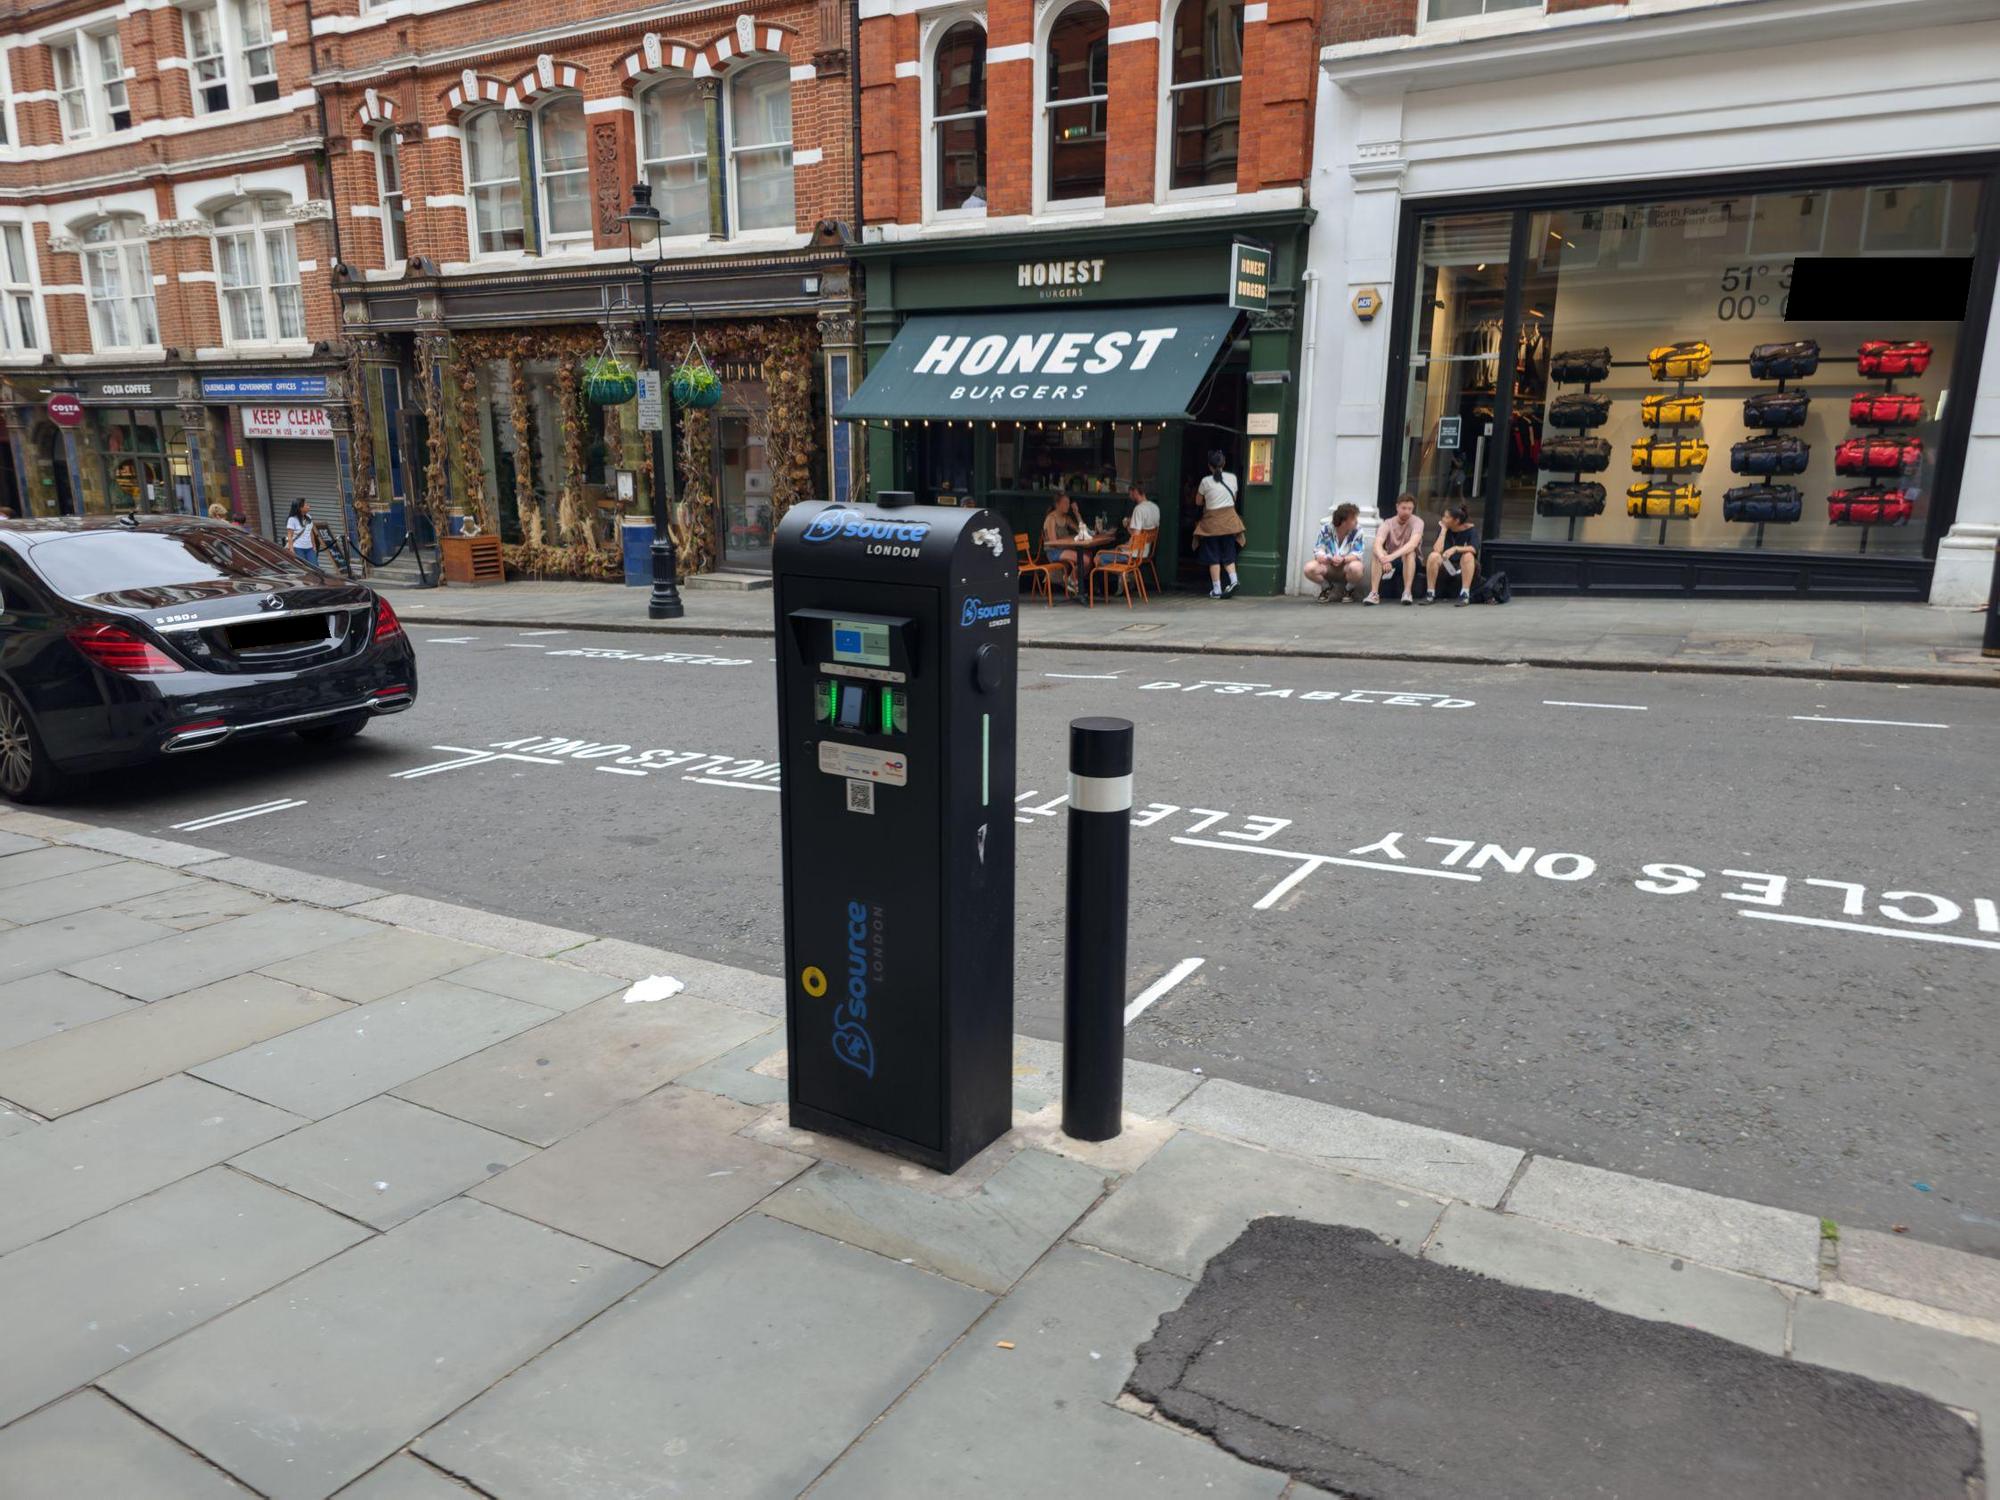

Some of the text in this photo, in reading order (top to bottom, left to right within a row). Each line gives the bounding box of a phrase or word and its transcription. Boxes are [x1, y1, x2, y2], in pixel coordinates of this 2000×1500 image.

[1018, 259, 1104, 286] HONEST
[1241, 258, 1265, 277] HONEST
[1040, 288, 1083, 299] BURGERS
[1238, 281, 1266, 299] BURGERS
[913, 328, 1178, 376] HONEST
[102, 384, 152, 396] COSTA COFFEE
[204, 383, 236, 392] QUEENSLAND
[239, 383, 273, 391] GOVERNMENT
[275, 383, 297, 391] OFFICES
[950, 384, 1088, 401] BURGERS
[51, 404, 80, 412] COSTA
[252, 408, 326, 425] KEEP CLEAR
[248, 427, 273, 435] ENTRANCE
[843, 520, 930, 542] source
[866, 545, 920, 558] LONDON
[977, 602, 1011, 617] source
[988, 618, 1011, 628] LONDON
[1137, 680, 1477, 709] DISABLED
[1349, 831, 1597, 881] ONLY
[872, 906, 884, 983] LONDON
[848, 901, 867, 1019] source
